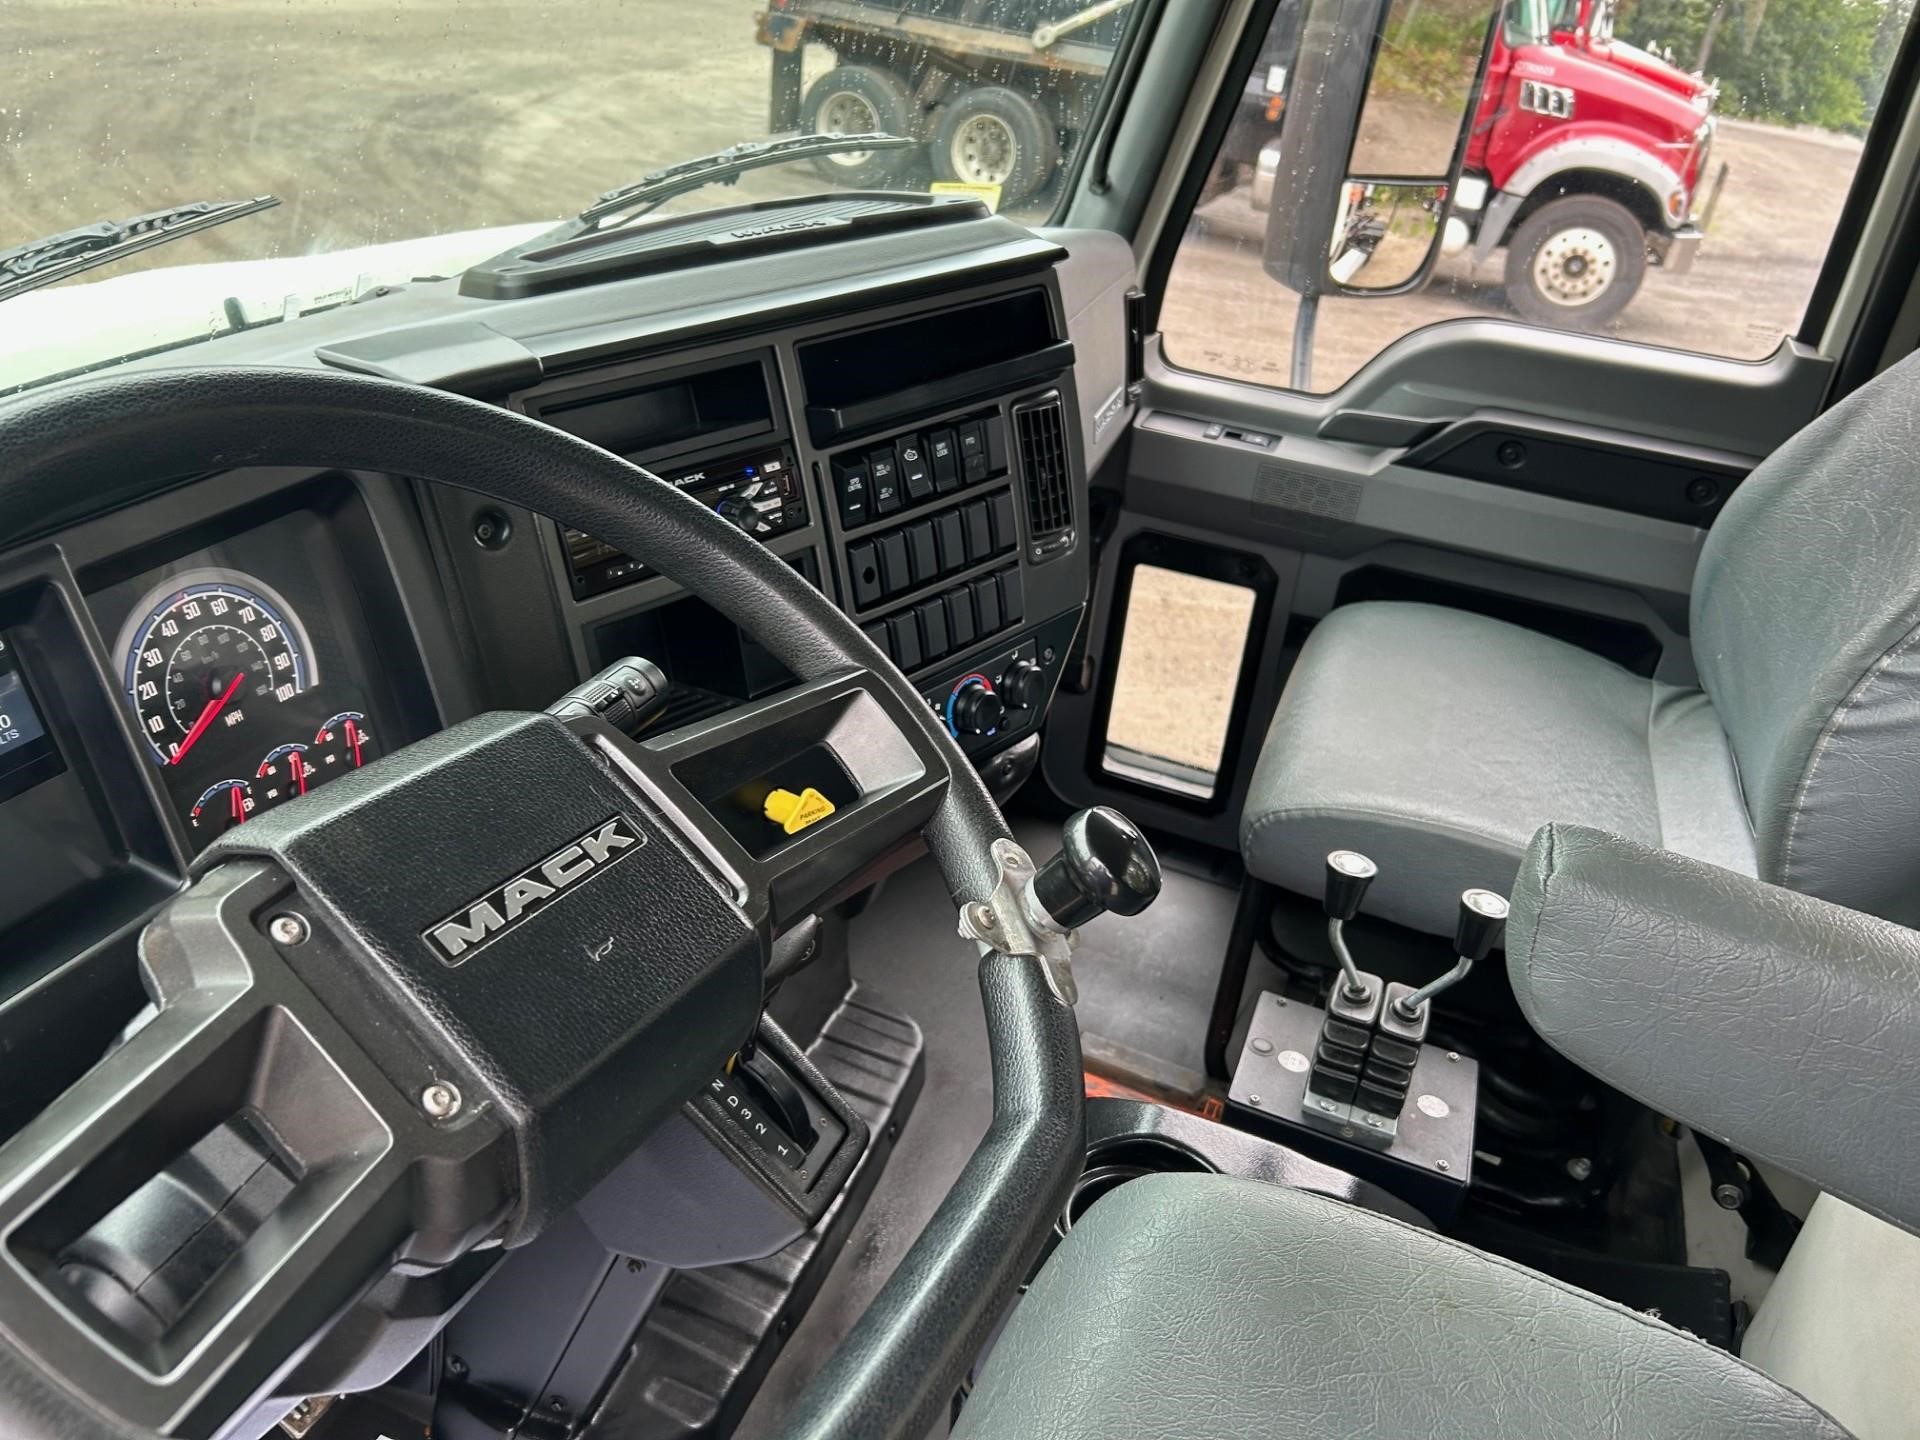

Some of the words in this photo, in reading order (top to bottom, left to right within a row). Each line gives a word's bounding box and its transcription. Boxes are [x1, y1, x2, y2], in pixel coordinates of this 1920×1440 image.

[731, 220, 827, 238] MACK
[183, 601, 201, 620] 50
[210, 598, 229, 616] 60
[238, 606, 256, 624] 70
[161, 620, 179, 638] 40
[260, 624, 278, 642] 80
[143, 648, 163, 667] 30
[274, 652, 290, 670] 90
[139, 681, 158, 700] 20
[275, 683, 295, 702] 100
[148, 714, 164, 733] 10
[224, 709, 244, 728] MPH
[433, 822, 636, 956] MACK
[712, 1079, 724, 1091] N
[727, 1095, 739, 1108] D
[741, 1108, 752, 1120] 3
[755, 1122, 767, 1135] 2
[777, 1145, 788, 1156] 1
